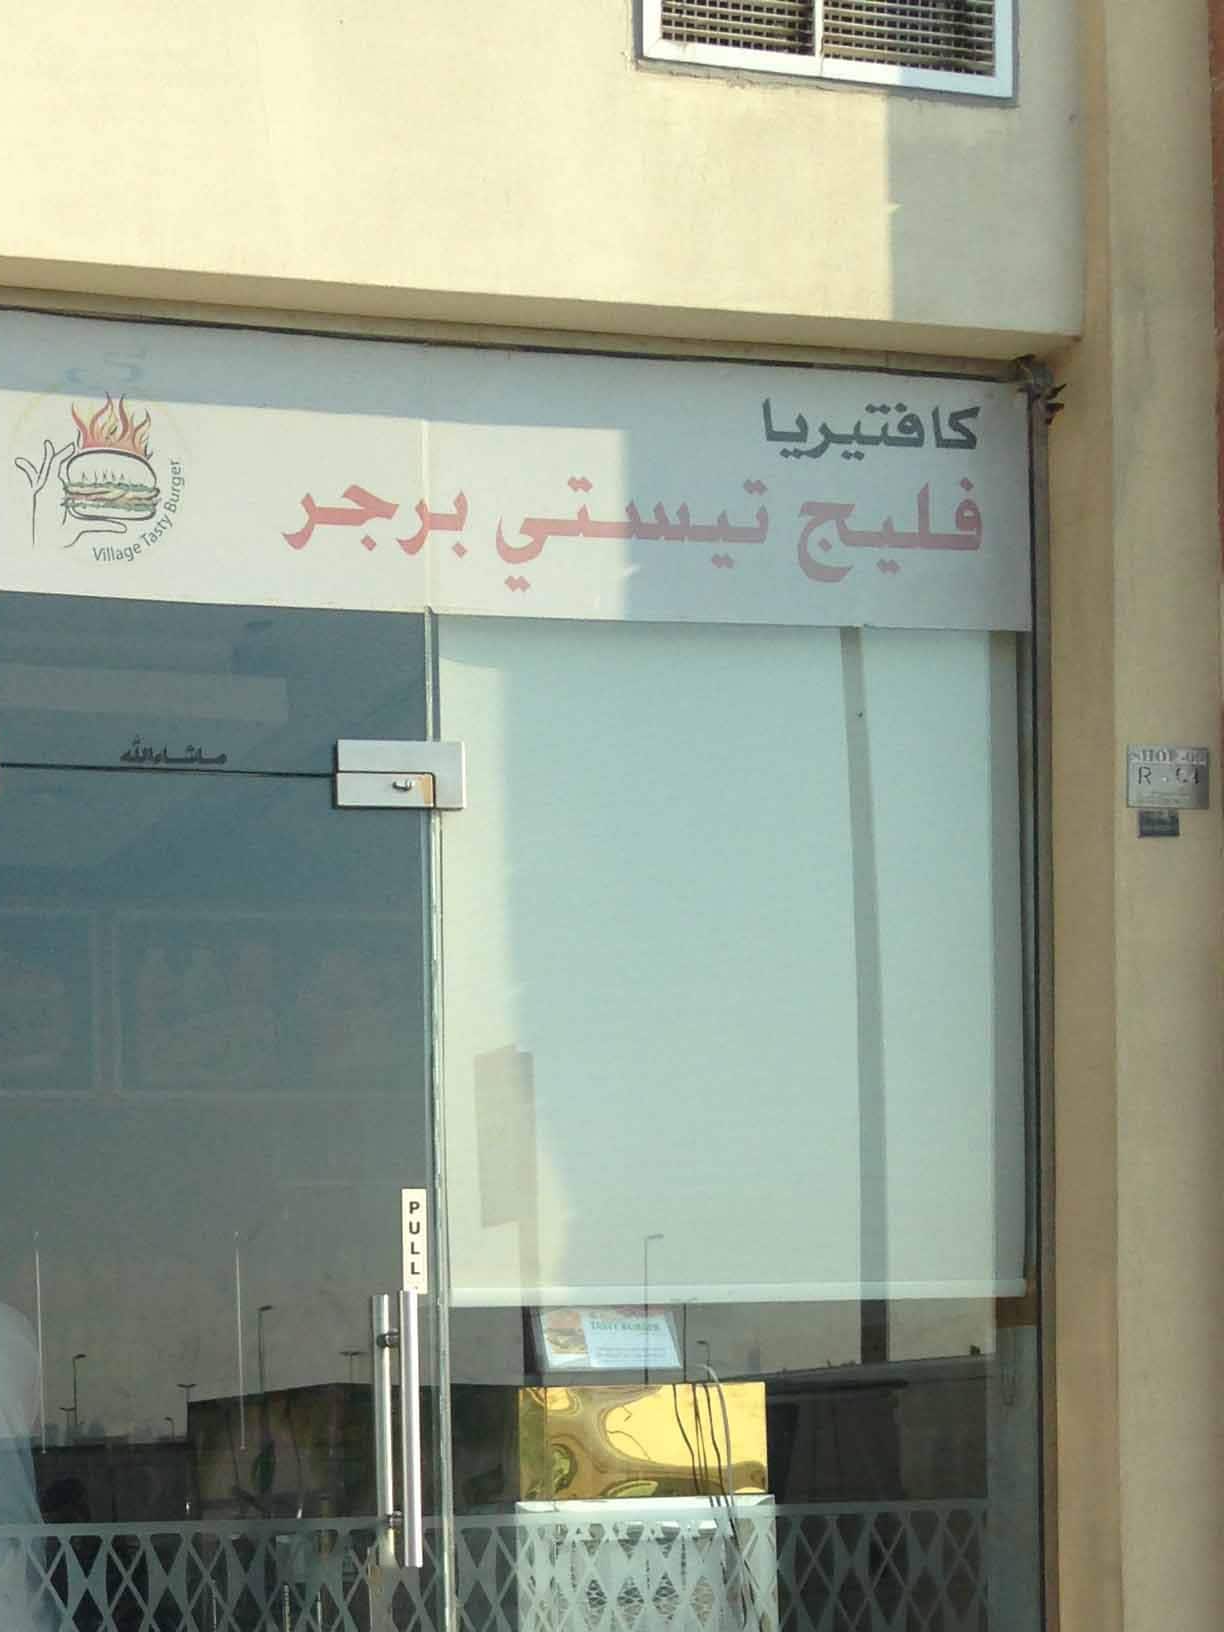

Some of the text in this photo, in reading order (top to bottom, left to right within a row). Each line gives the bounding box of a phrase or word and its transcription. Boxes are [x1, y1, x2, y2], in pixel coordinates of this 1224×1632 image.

[762, 399, 981, 461] كافتيريا
[91, 459, 184, 562] Village Tasty Burger
[281, 474, 983, 593] فليج تيستي برجر
[408, 1201, 421, 1275] PULL
